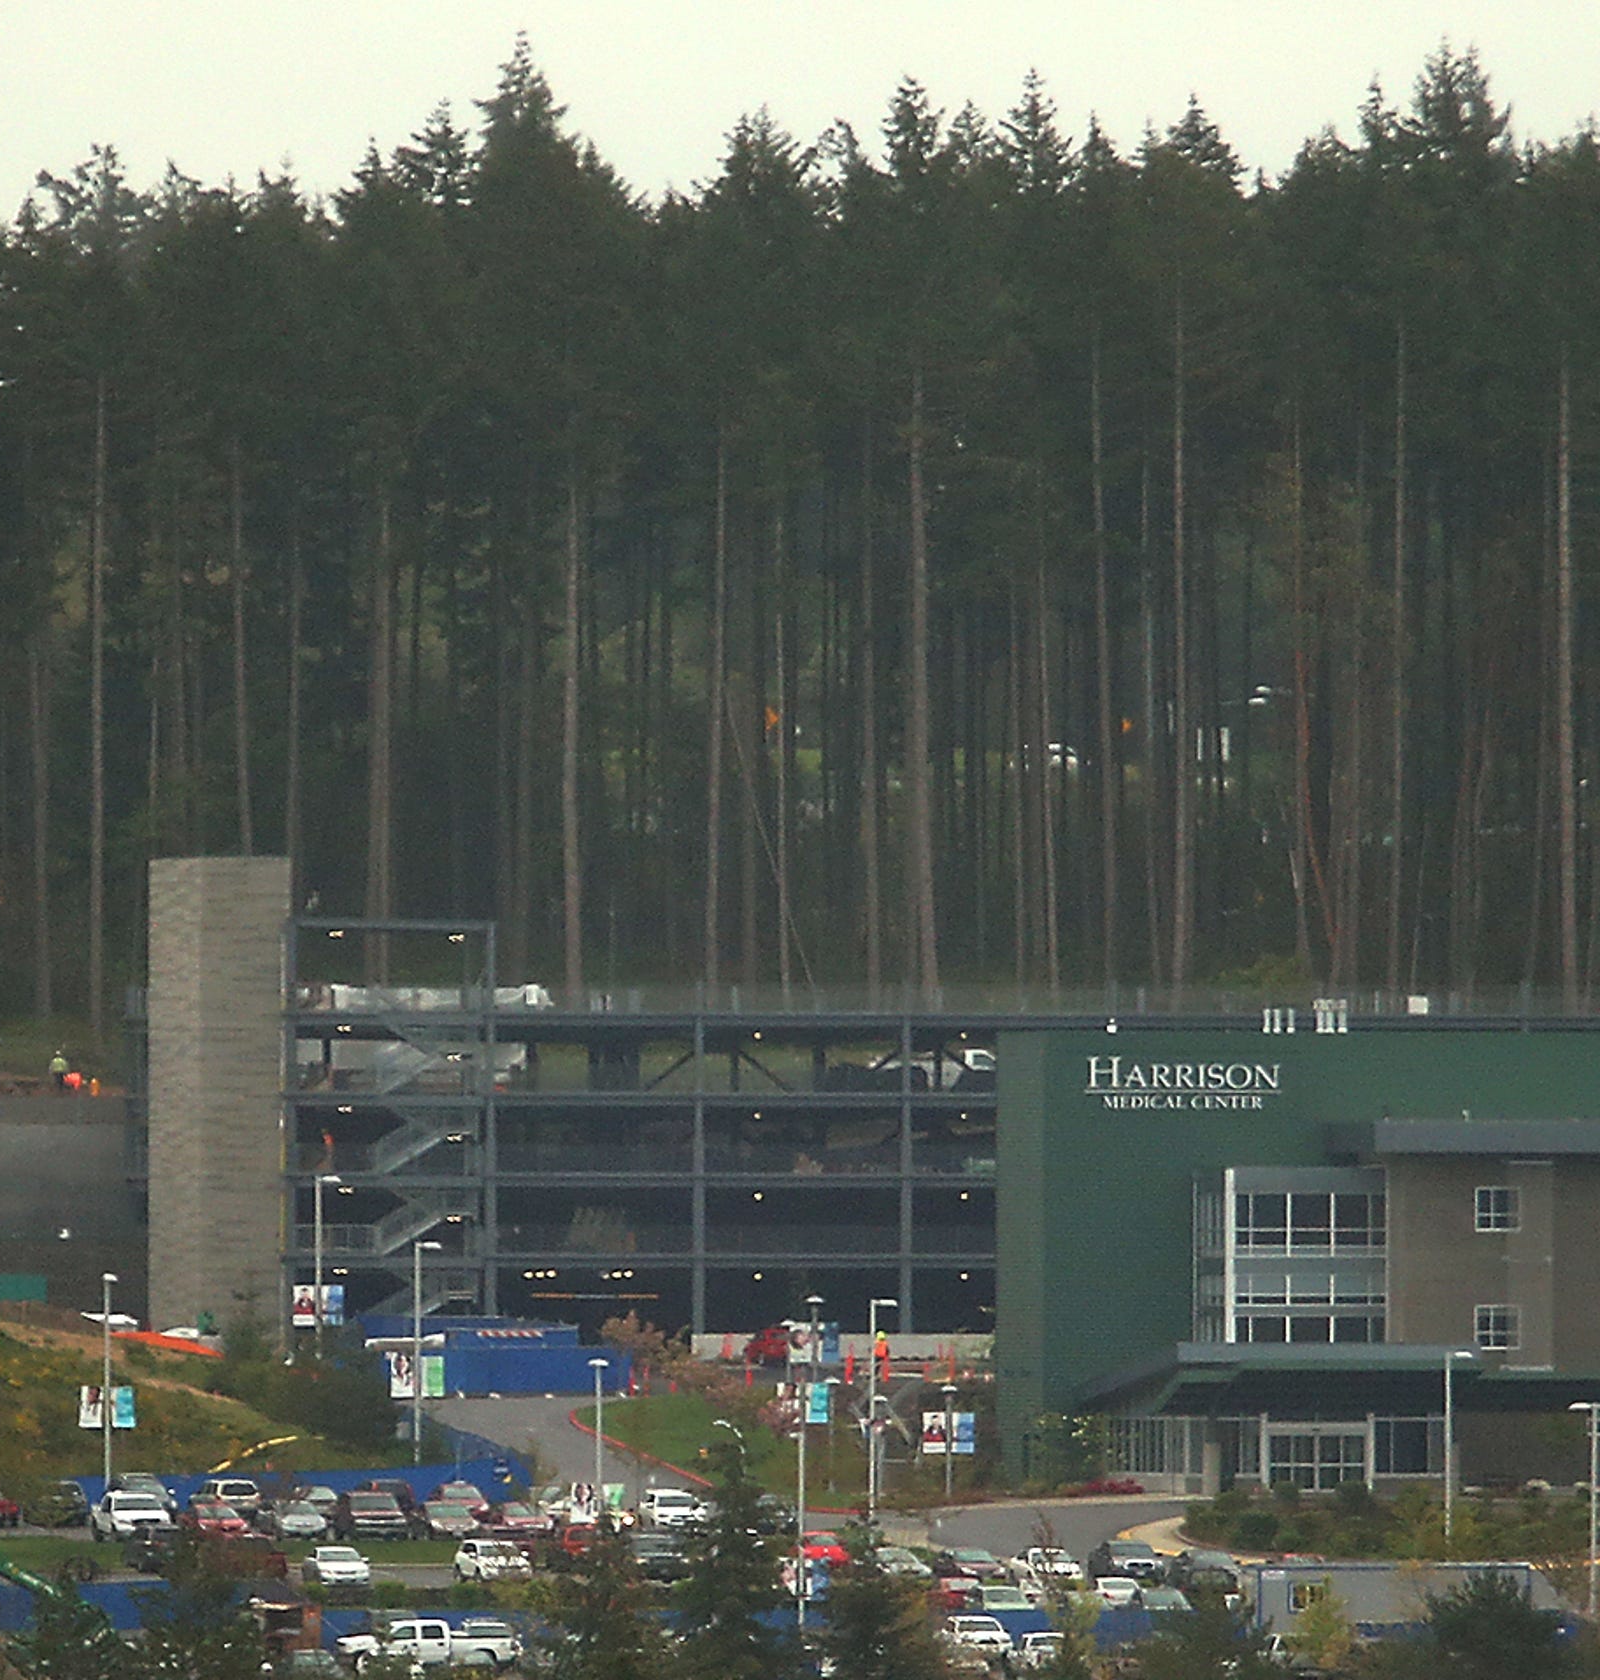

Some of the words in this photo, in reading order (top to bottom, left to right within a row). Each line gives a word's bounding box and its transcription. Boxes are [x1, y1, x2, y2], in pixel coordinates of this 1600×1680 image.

[1087, 1056, 1280, 1089] HARRISON
[1103, 1095, 1186, 1110] MEDICAL
[1190, 1095, 1263, 1110] CENTER
